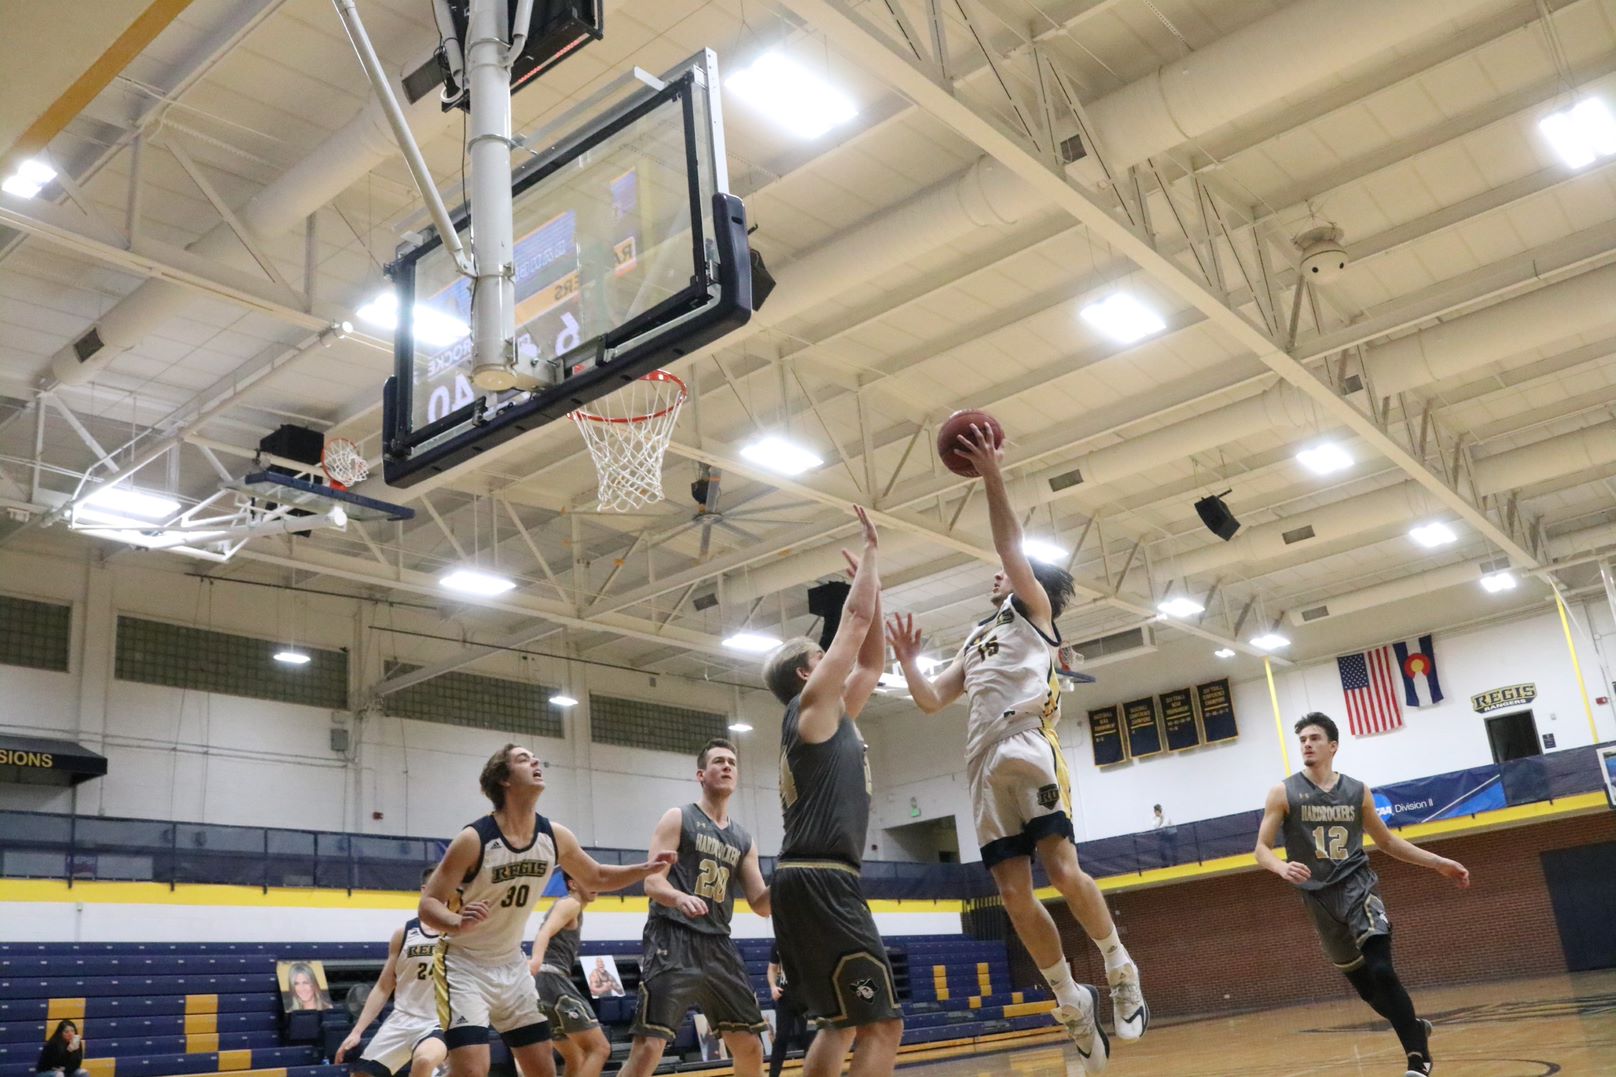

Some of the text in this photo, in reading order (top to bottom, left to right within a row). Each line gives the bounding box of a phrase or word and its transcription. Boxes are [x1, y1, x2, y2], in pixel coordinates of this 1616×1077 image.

[1474, 685, 1536, 709] REGIS
[1484, 698, 1527, 712] RANGERS
[0, 749, 53, 768] SIONS
[1395, 800, 1427, 813] Division
[1312, 825, 1349, 860] 12
[492, 860, 548, 882] REGIS
[501, 884, 529, 908] 30
